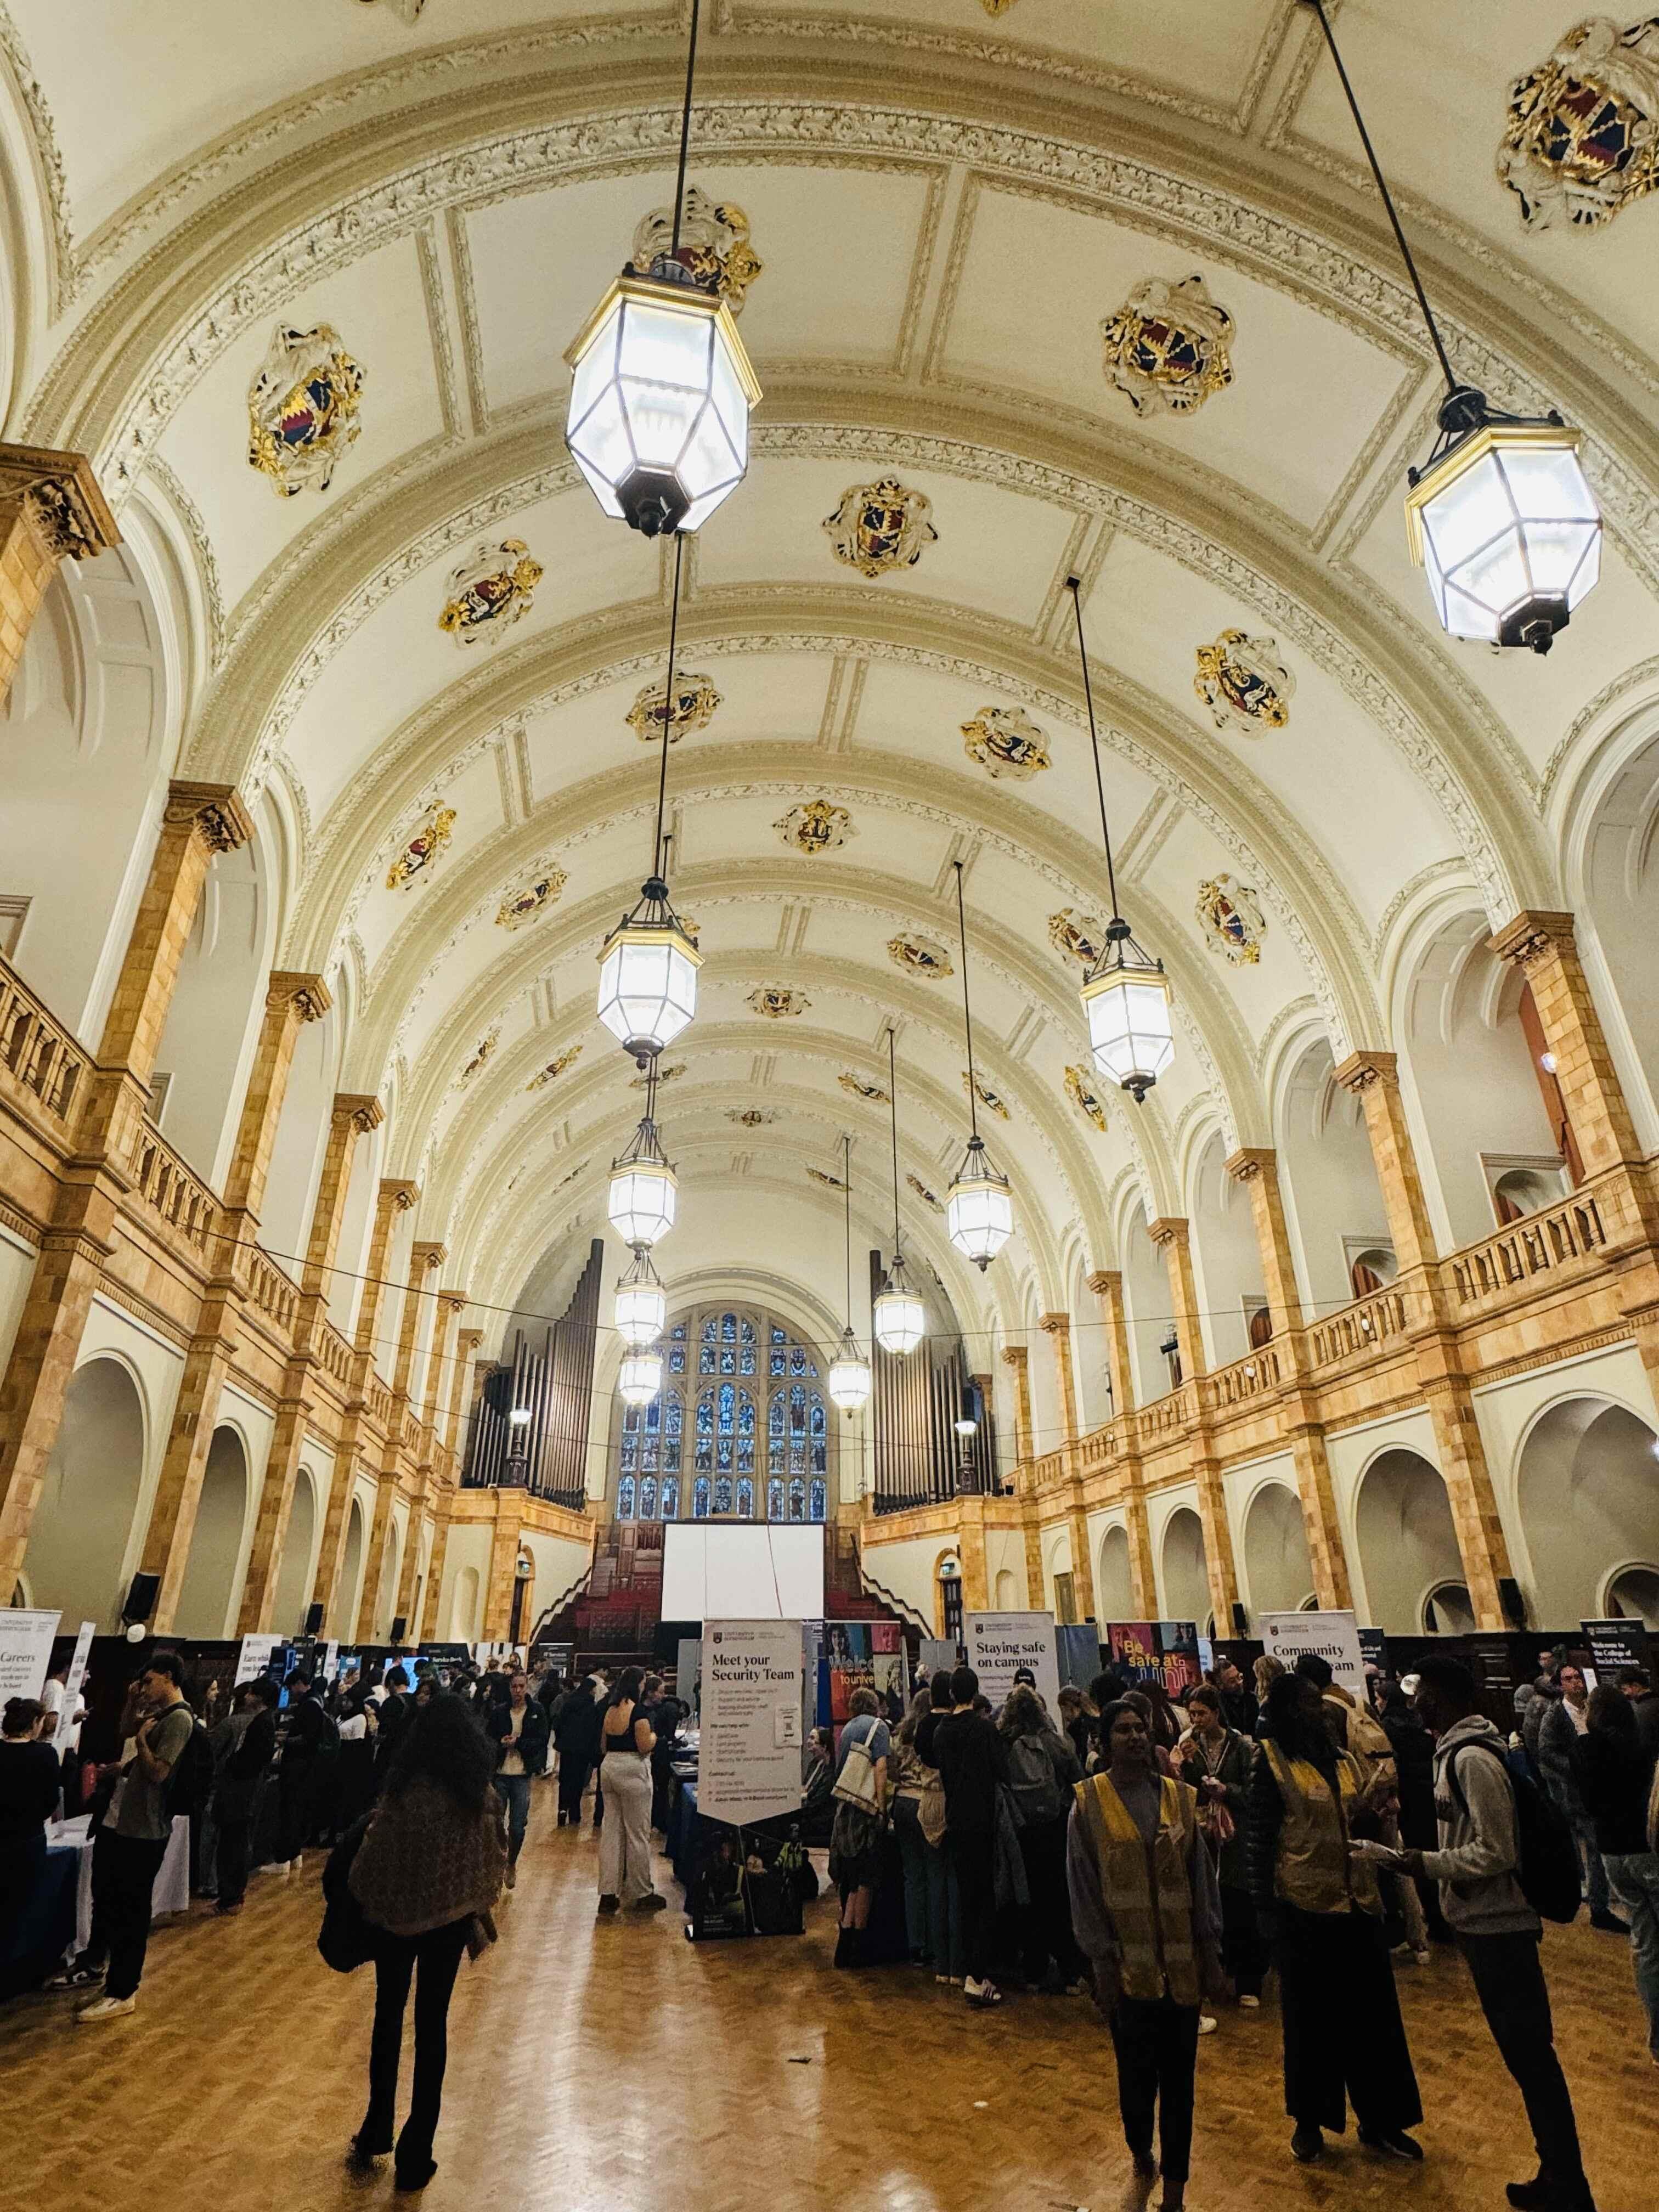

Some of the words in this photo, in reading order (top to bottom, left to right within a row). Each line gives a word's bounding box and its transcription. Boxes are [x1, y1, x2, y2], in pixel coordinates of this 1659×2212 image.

[977, 1641, 1019, 1655] Staying
[1022, 1641, 1046, 1652] safe
[1124, 1640, 1144, 1654] Be
[1273, 1644, 1345, 1657] Community
[1, 1652, 35, 1662] Careers
[713, 1654, 741, 1666] Meet
[744, 1656, 770, 1668] your
[995, 1658, 1039, 1669] campus
[1128, 1654, 1160, 1667] safe
[1163, 1654, 1178, 1667] at
[712, 1668, 759, 1683] Security
[763, 1668, 794, 1680] Team
